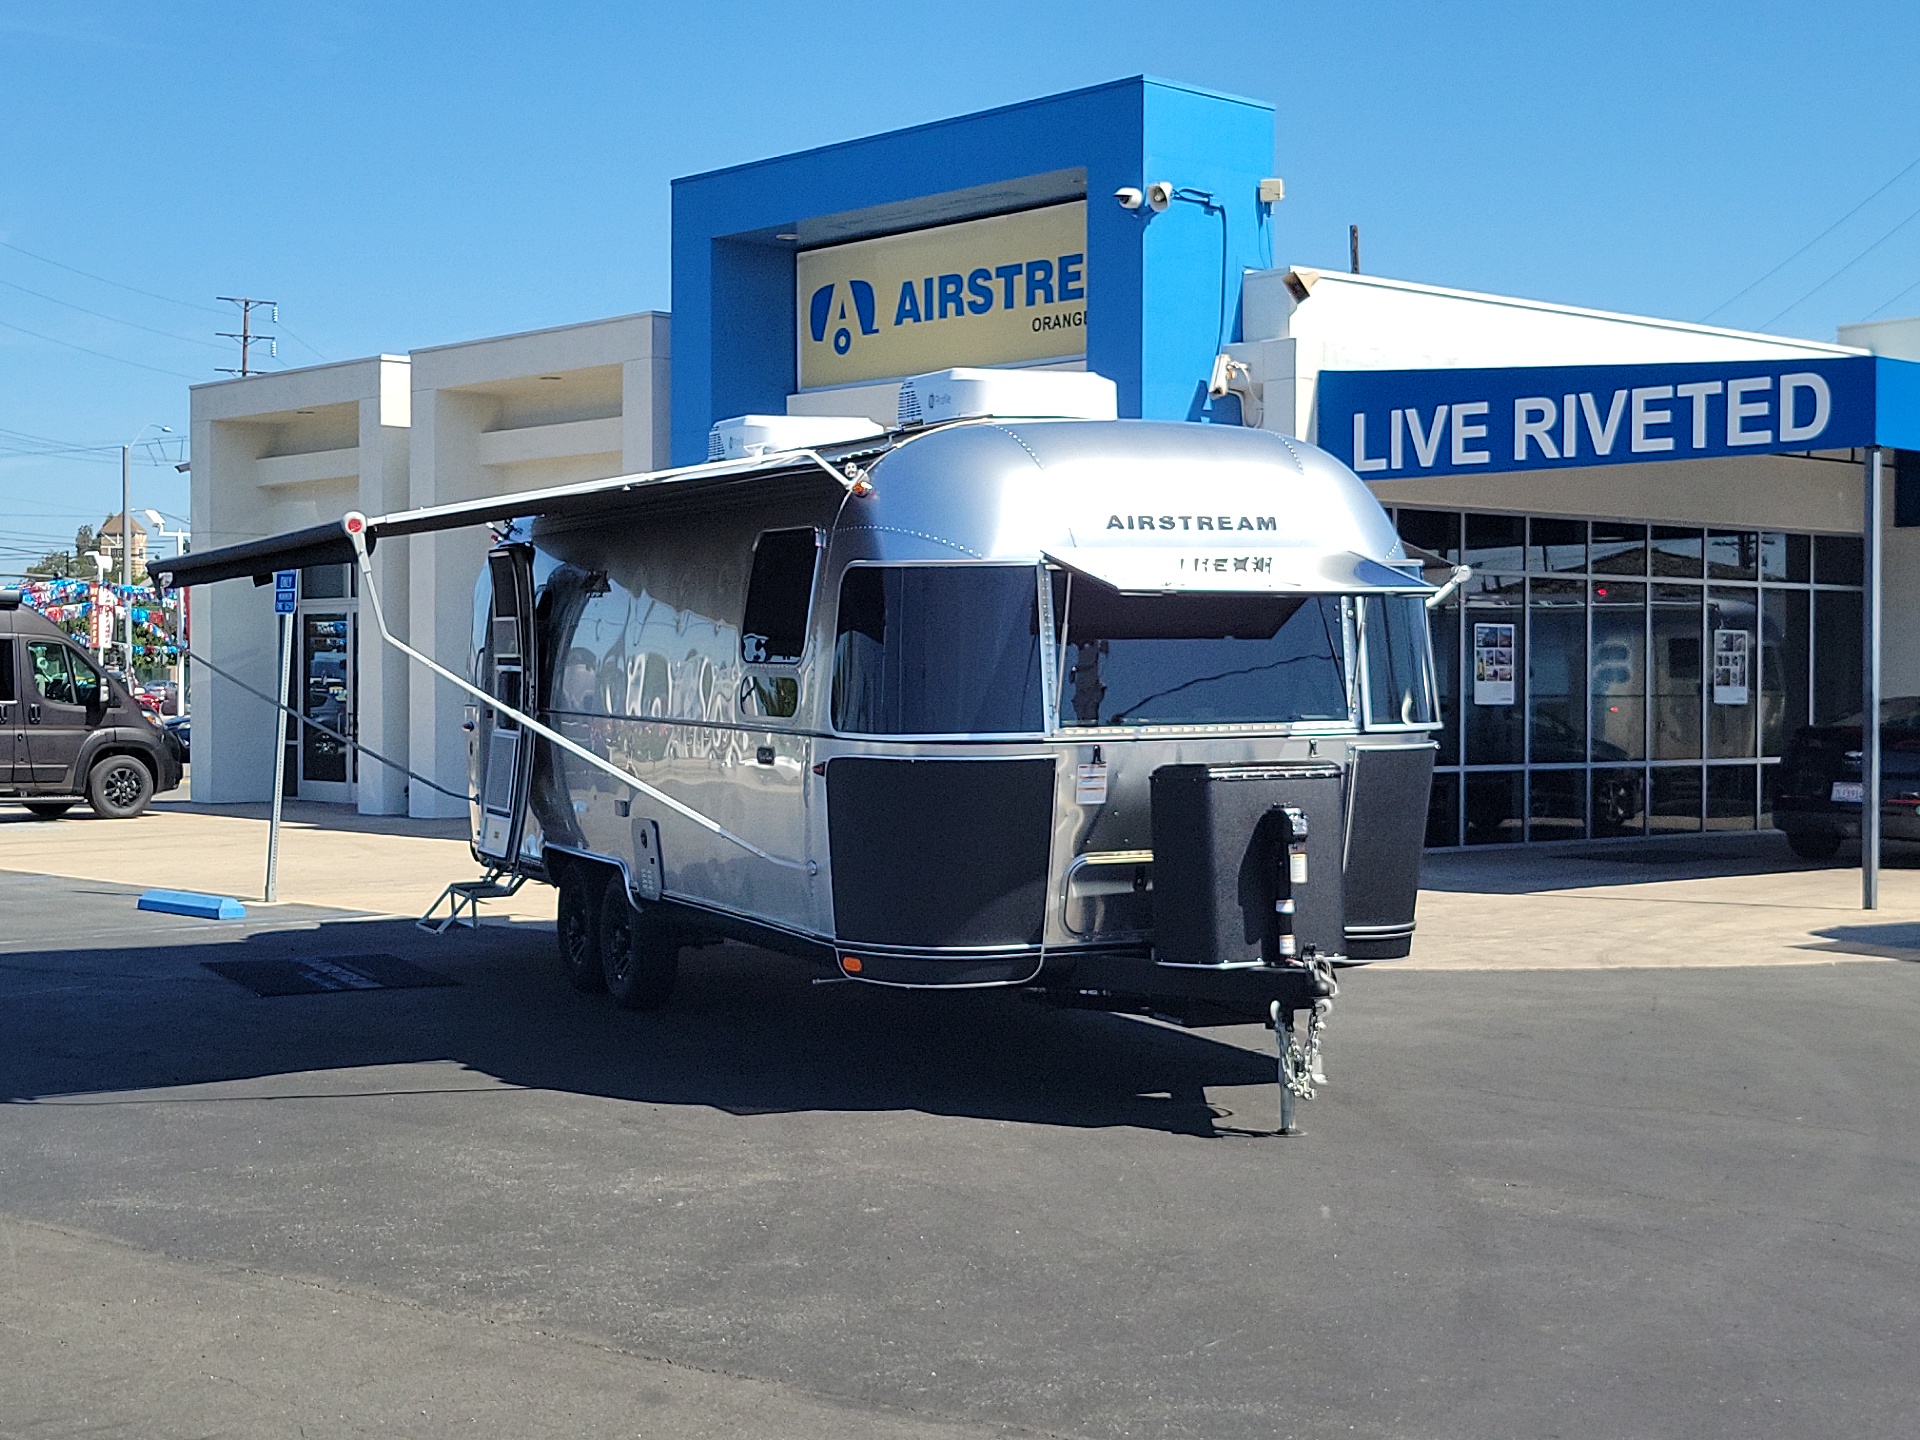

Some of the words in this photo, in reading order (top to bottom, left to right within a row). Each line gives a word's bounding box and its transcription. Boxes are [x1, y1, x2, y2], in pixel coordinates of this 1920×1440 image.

[893, 253, 1085, 326] AIRSTRE
[1353, 401, 1491, 473] LIVE
[1513, 371, 1832, 462] RIVETED
[1106, 514, 1278, 532] AIRSTREAM
